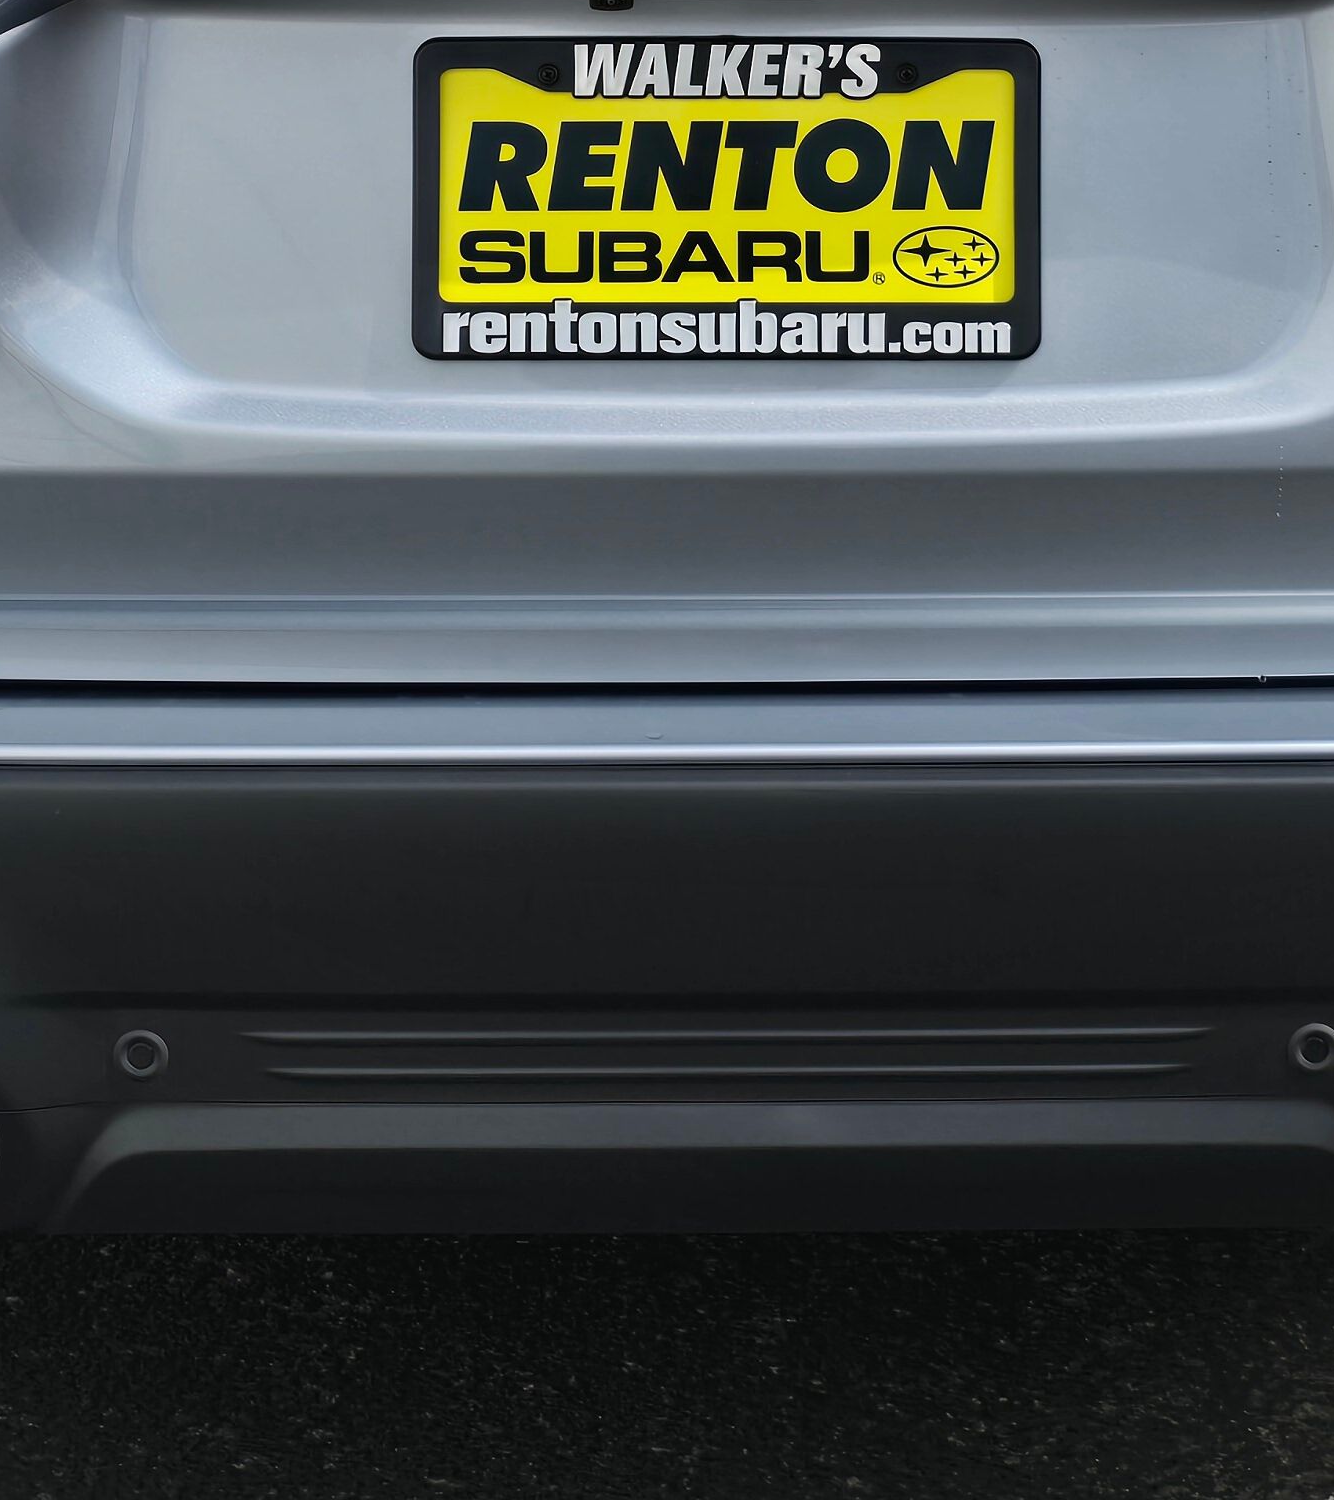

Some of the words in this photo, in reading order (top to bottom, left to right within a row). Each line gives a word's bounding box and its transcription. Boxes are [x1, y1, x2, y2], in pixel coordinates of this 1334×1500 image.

[458, 118, 995, 213] RENTON
[458, 230, 870, 284] SUBARU
[441, 299, 1012, 355] rentonsubaru.com
